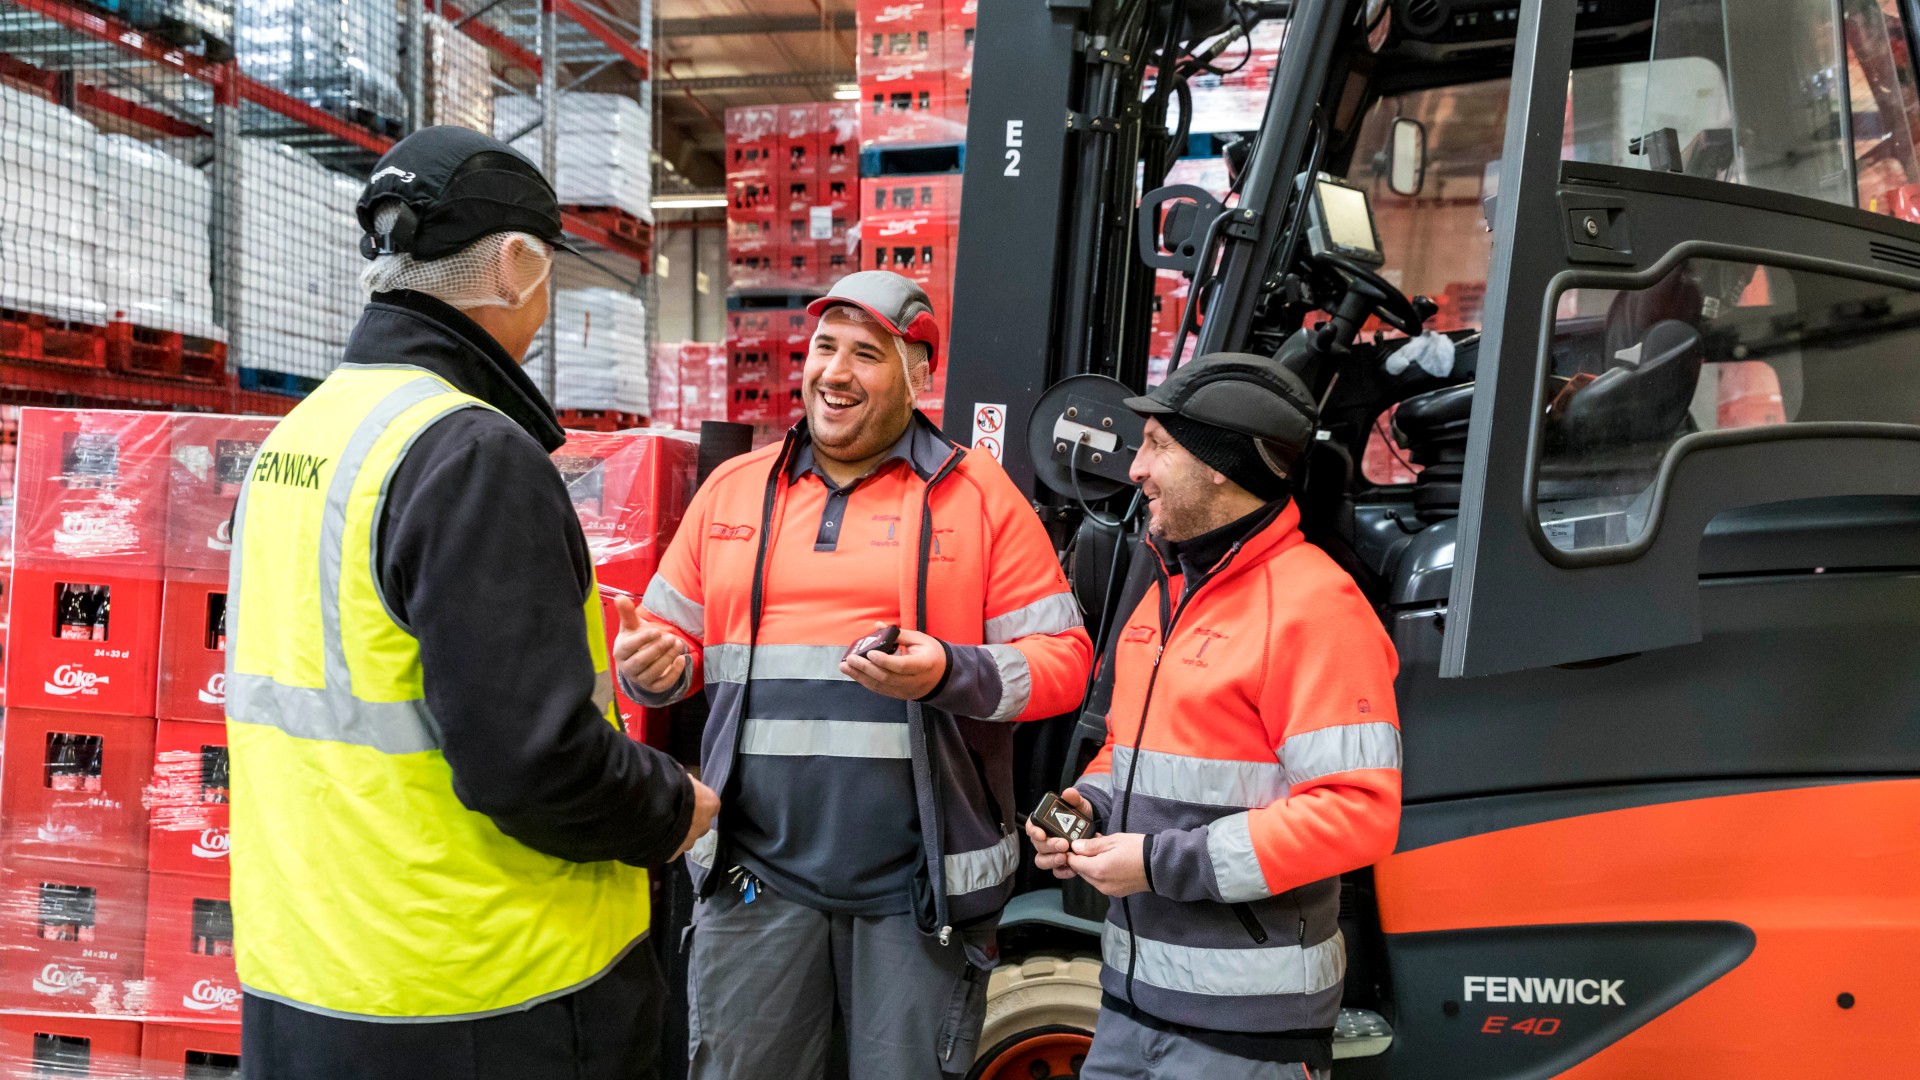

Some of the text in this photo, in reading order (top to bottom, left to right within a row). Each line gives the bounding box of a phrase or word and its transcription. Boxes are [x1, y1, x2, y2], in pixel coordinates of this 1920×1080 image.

[1006, 120, 1023, 147] E
[1004, 149, 1021, 176] 2
[252, 452, 328, 489] FENWICK
[53, 664, 109, 688] Coke
[200, 828, 230, 850] Cok
[41, 963, 97, 988] Coke
[192, 979, 242, 1004] Coke
[1464, 976, 1626, 1006] FENWICK
[1481, 1016, 1561, 1035] E 40
